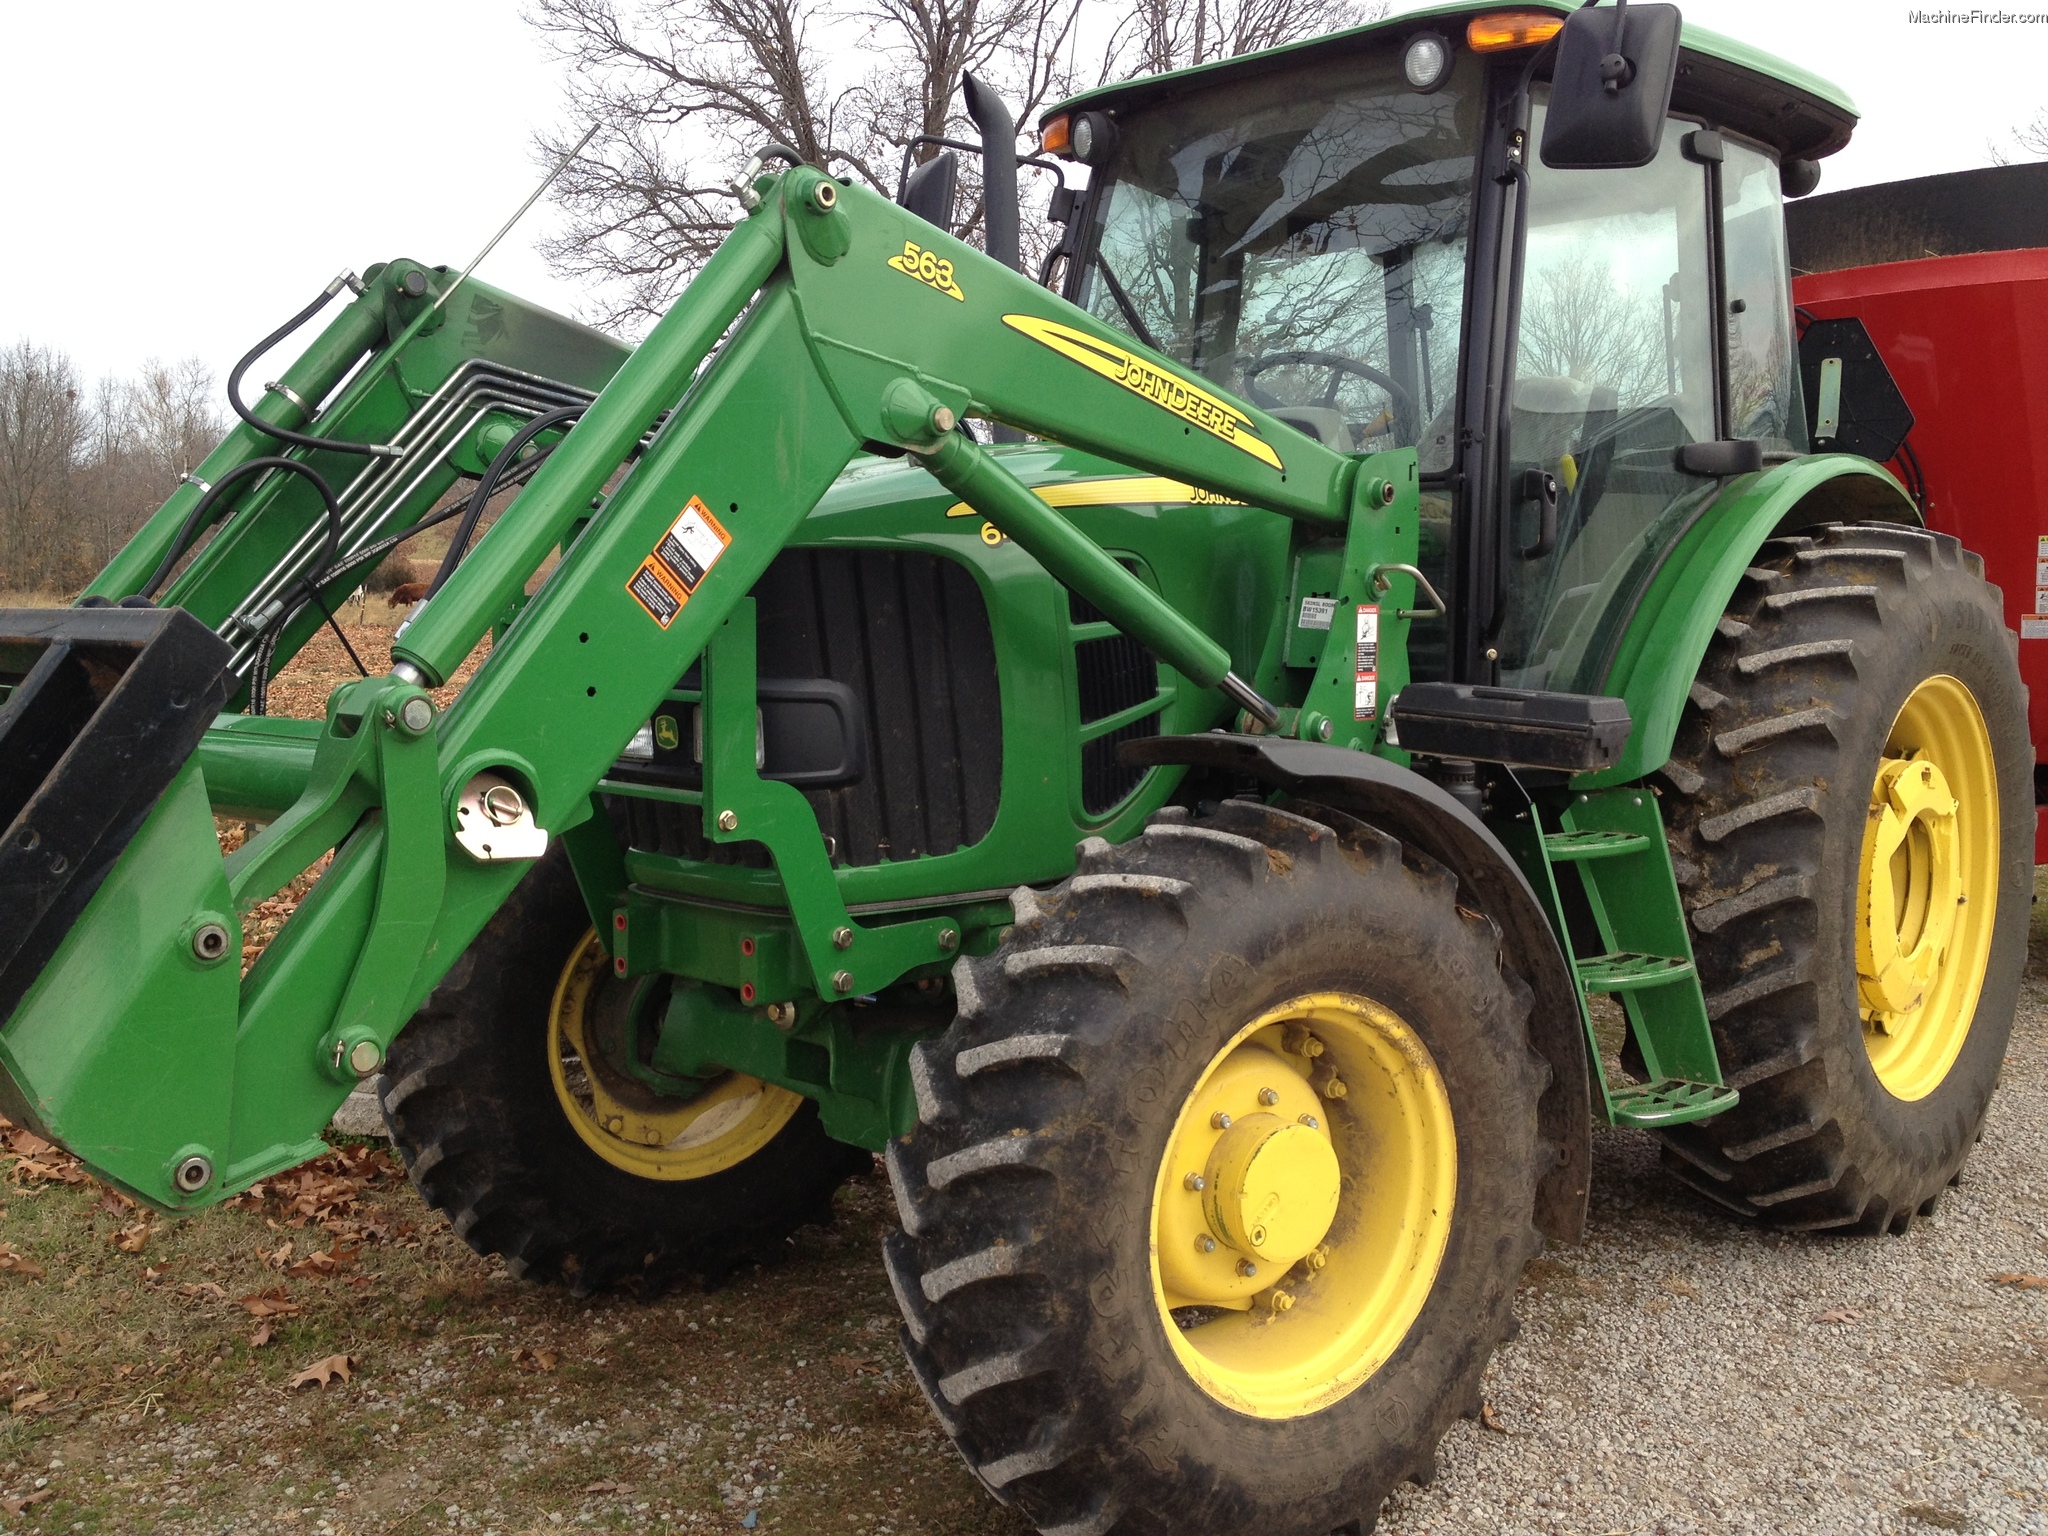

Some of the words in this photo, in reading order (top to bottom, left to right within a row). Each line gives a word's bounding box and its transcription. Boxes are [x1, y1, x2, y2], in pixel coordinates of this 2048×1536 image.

[902, 239, 954, 291] 563
[1114, 355, 1172, 405] JOHN
[1169, 380, 1237, 440] DEERE
[700, 509, 726, 541] WARNING
[656, 569, 682, 600] WARNING
